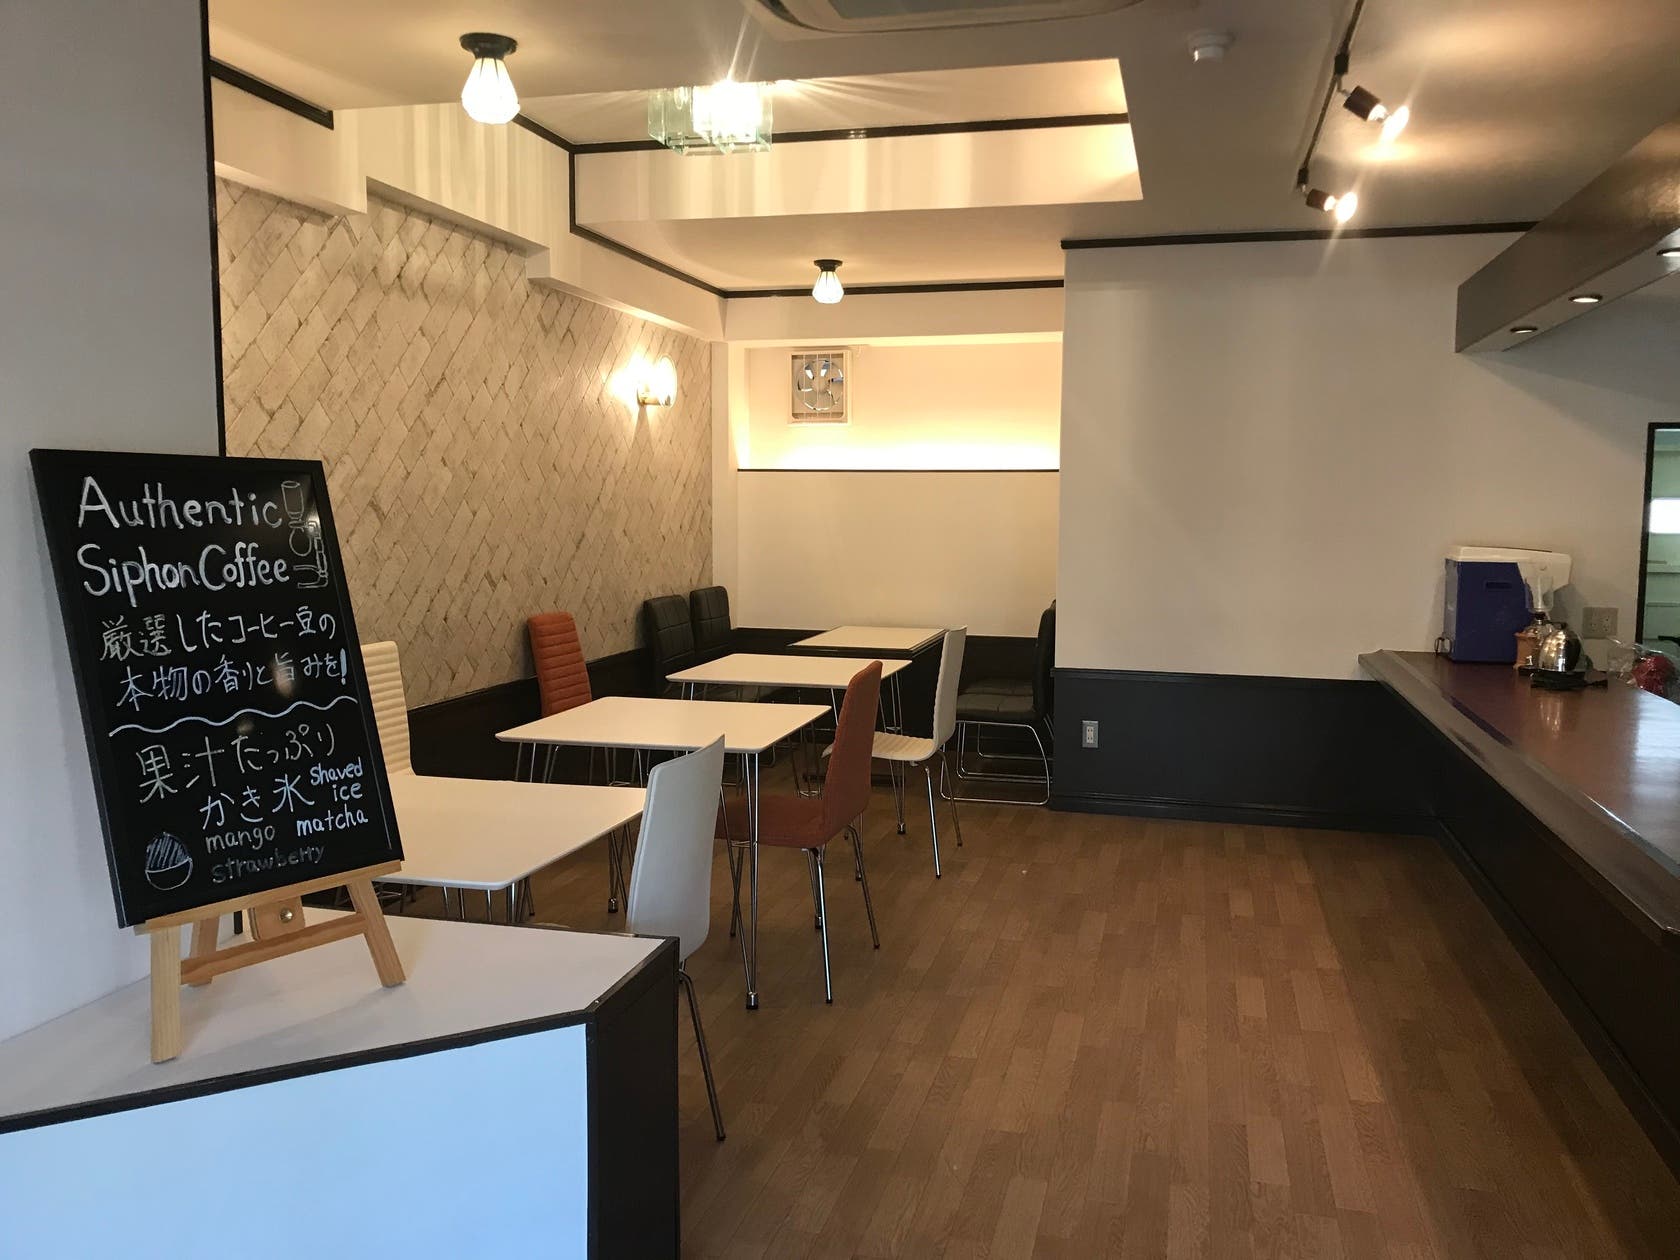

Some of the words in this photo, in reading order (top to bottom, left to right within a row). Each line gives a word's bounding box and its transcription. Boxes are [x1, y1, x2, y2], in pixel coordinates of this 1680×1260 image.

[77, 476, 283, 529] Authentic
[76, 543, 203, 607] Siphon
[199, 543, 290, 592] Coffee
[98, 605, 336, 662] 厳選したコーヒー豆の
[135, 722, 336, 804] 果汁たっぷり
[199, 773, 315, 830] かき氷
[332, 781, 364, 803] ice
[205, 825, 276, 853] mango
[296, 803, 369, 837] matcha
